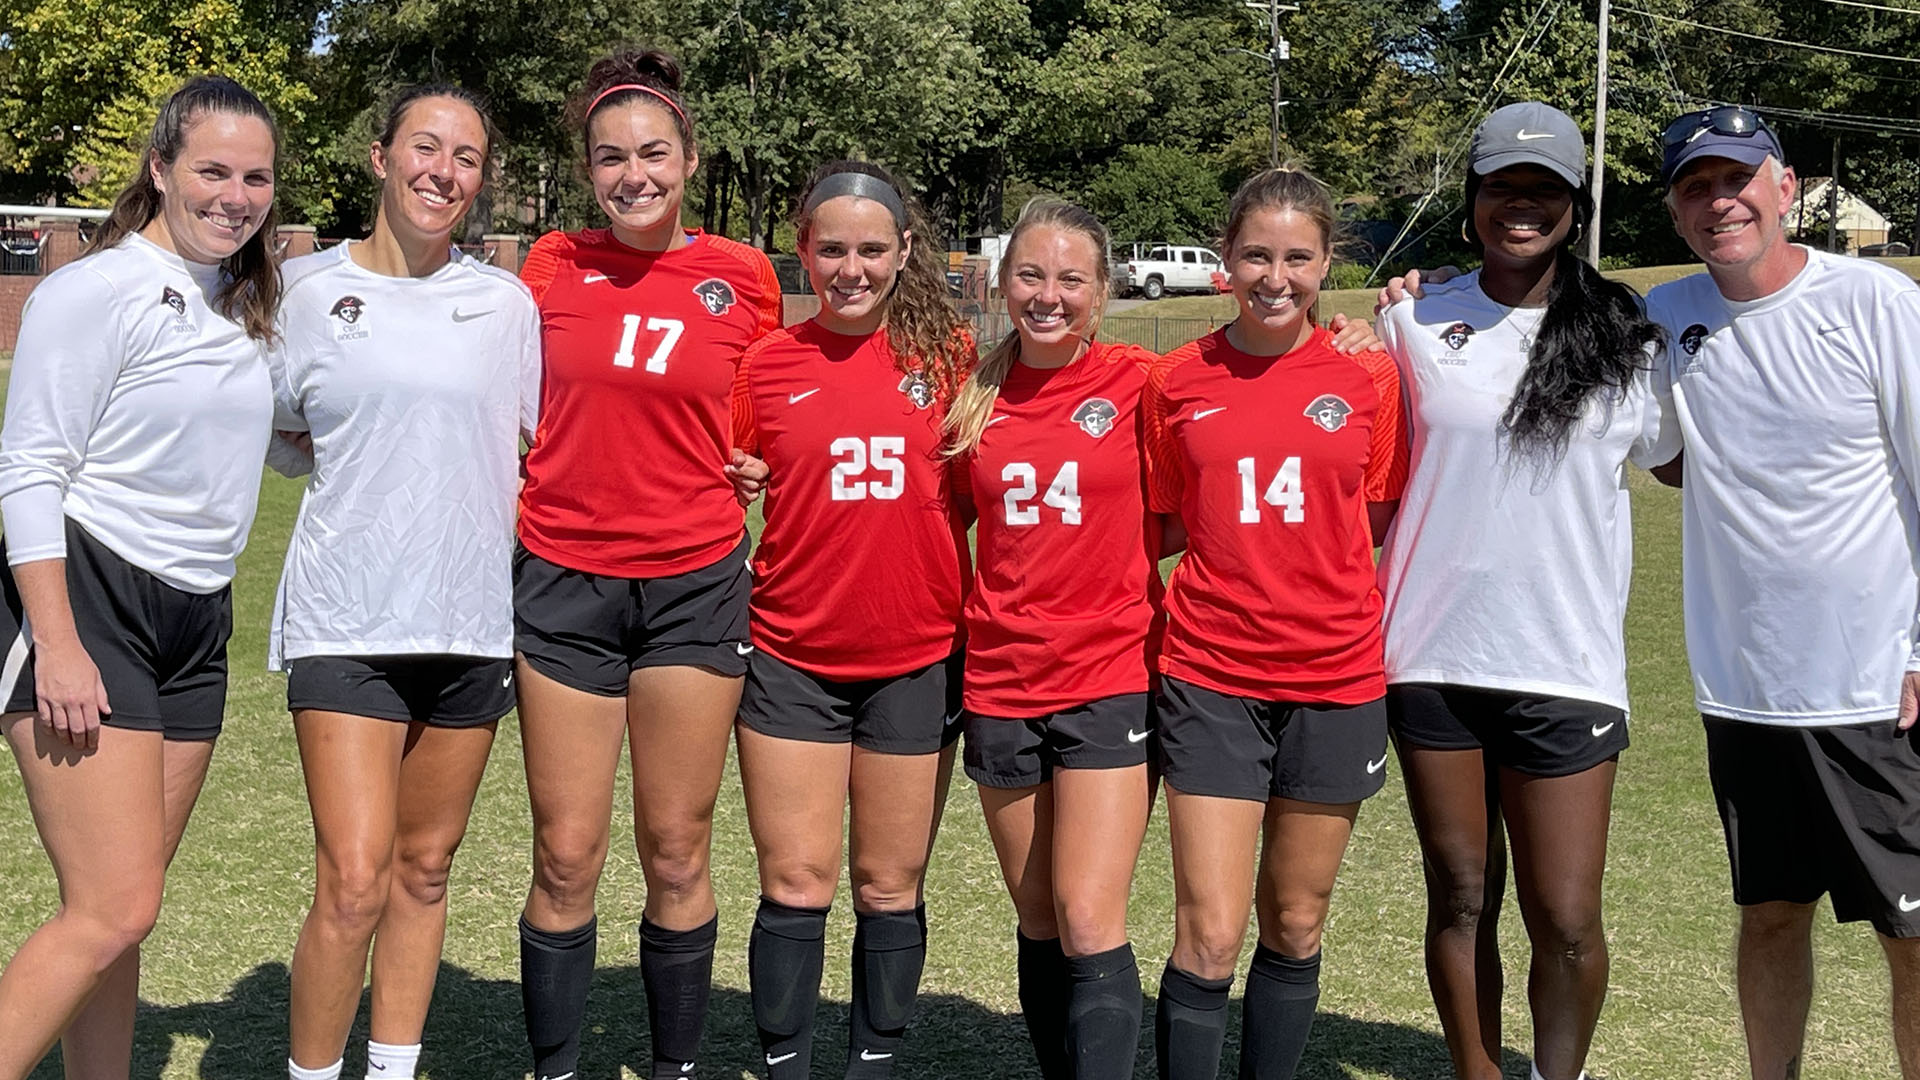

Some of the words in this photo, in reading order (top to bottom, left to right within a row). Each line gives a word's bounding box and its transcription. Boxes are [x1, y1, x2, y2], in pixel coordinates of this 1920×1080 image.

[613, 314, 685, 375] 17
[830, 436, 905, 500] 25
[1001, 461, 1082, 525] 24
[1237, 456, 1305, 524] 14
